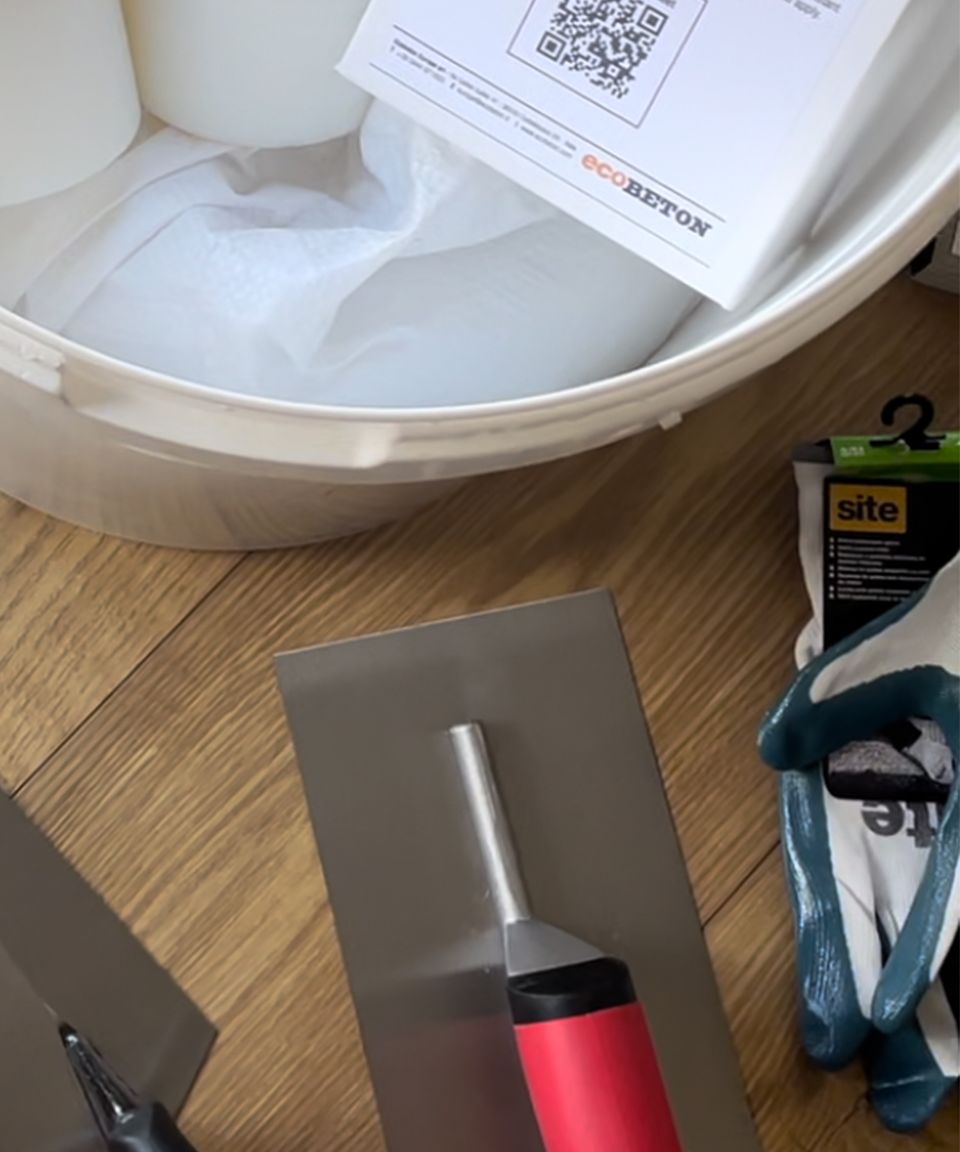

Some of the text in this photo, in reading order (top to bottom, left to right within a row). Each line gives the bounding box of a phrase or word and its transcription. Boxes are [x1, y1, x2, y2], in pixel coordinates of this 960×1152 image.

[581, 152, 713, 238] ecoBETON
[837, 494, 899, 523] site
[861, 801, 942, 849] te
